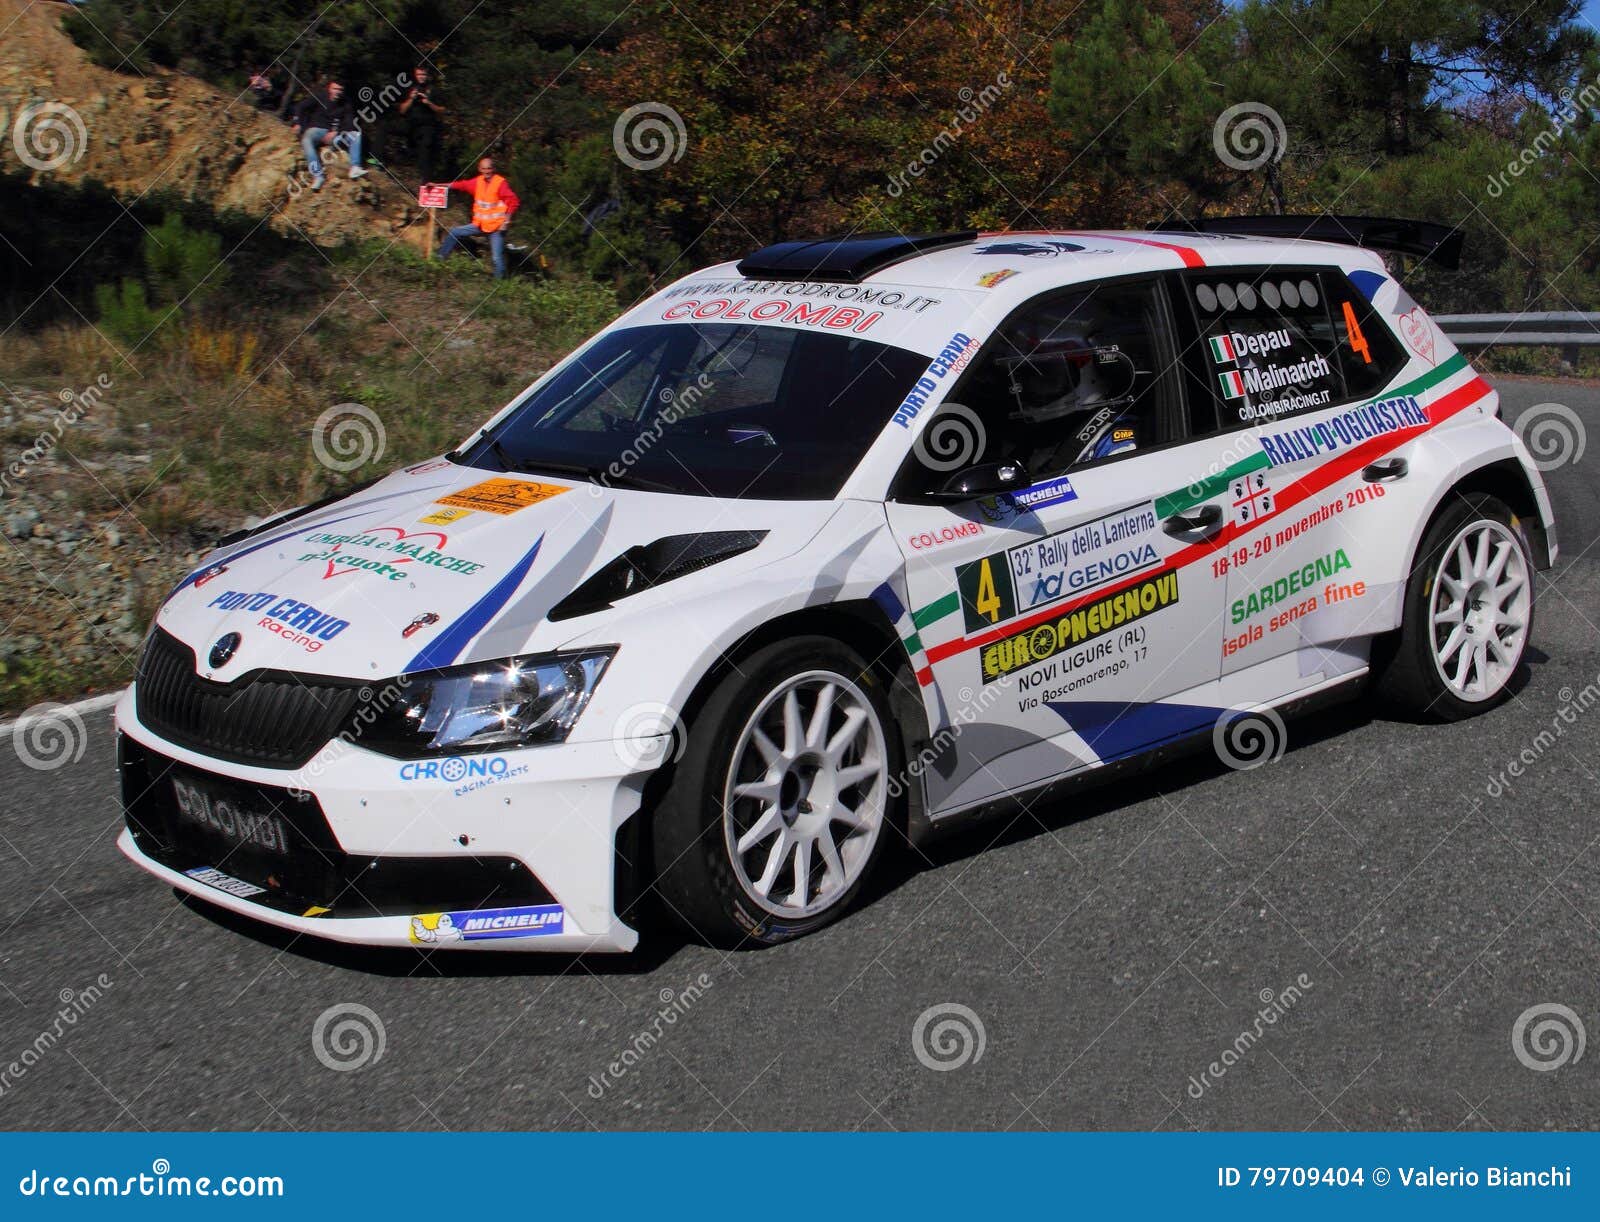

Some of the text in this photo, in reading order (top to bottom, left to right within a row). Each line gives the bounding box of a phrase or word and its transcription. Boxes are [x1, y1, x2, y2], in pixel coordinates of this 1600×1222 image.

[661, 299, 884, 334] COLOMBI
[1342, 301, 1372, 364] 4
[1231, 329, 1292, 357] Depau
[892, 332, 970, 429] PORTO CERVO
[1243, 354, 1330, 394] Malinarich
[1238, 390, 1331, 421] COLOMBIRACING.IT
[1113, 430, 1134, 441] OMP
[1260, 396, 1429, 466] RALLY D'OGLIASTRA
[1016, 482, 1071, 504] MICHELIN
[910, 521, 985, 550] COLOMBI
[1037, 539, 1069, 571] Rally
[1072, 525, 1102, 556] della
[1103, 511, 1156, 545] Lanterna
[1211, 483, 1386, 579] 18-19-20 novembre 2016
[334, 555, 408, 581] cuore
[388, 541, 485, 576] MARCHE
[1069, 543, 1157, 588] GENOVA
[976, 558, 1001, 623] 4
[1231, 548, 1352, 625] SARDEGNA
[207, 590, 351, 641] PORTO CERVO
[257, 617, 324, 653] Racing
[1223, 580, 1367, 657] isola senza fine
[1018, 625, 1147, 693] NOVI LIGURE (AL)
[1018, 697, 1038, 713] Via
[1133, 646, 1148, 663] 17
[400, 756, 508, 783] CHRONO
[454, 765, 529, 797] RACING PARTS
[464, 911, 563, 931] MICHELIN
